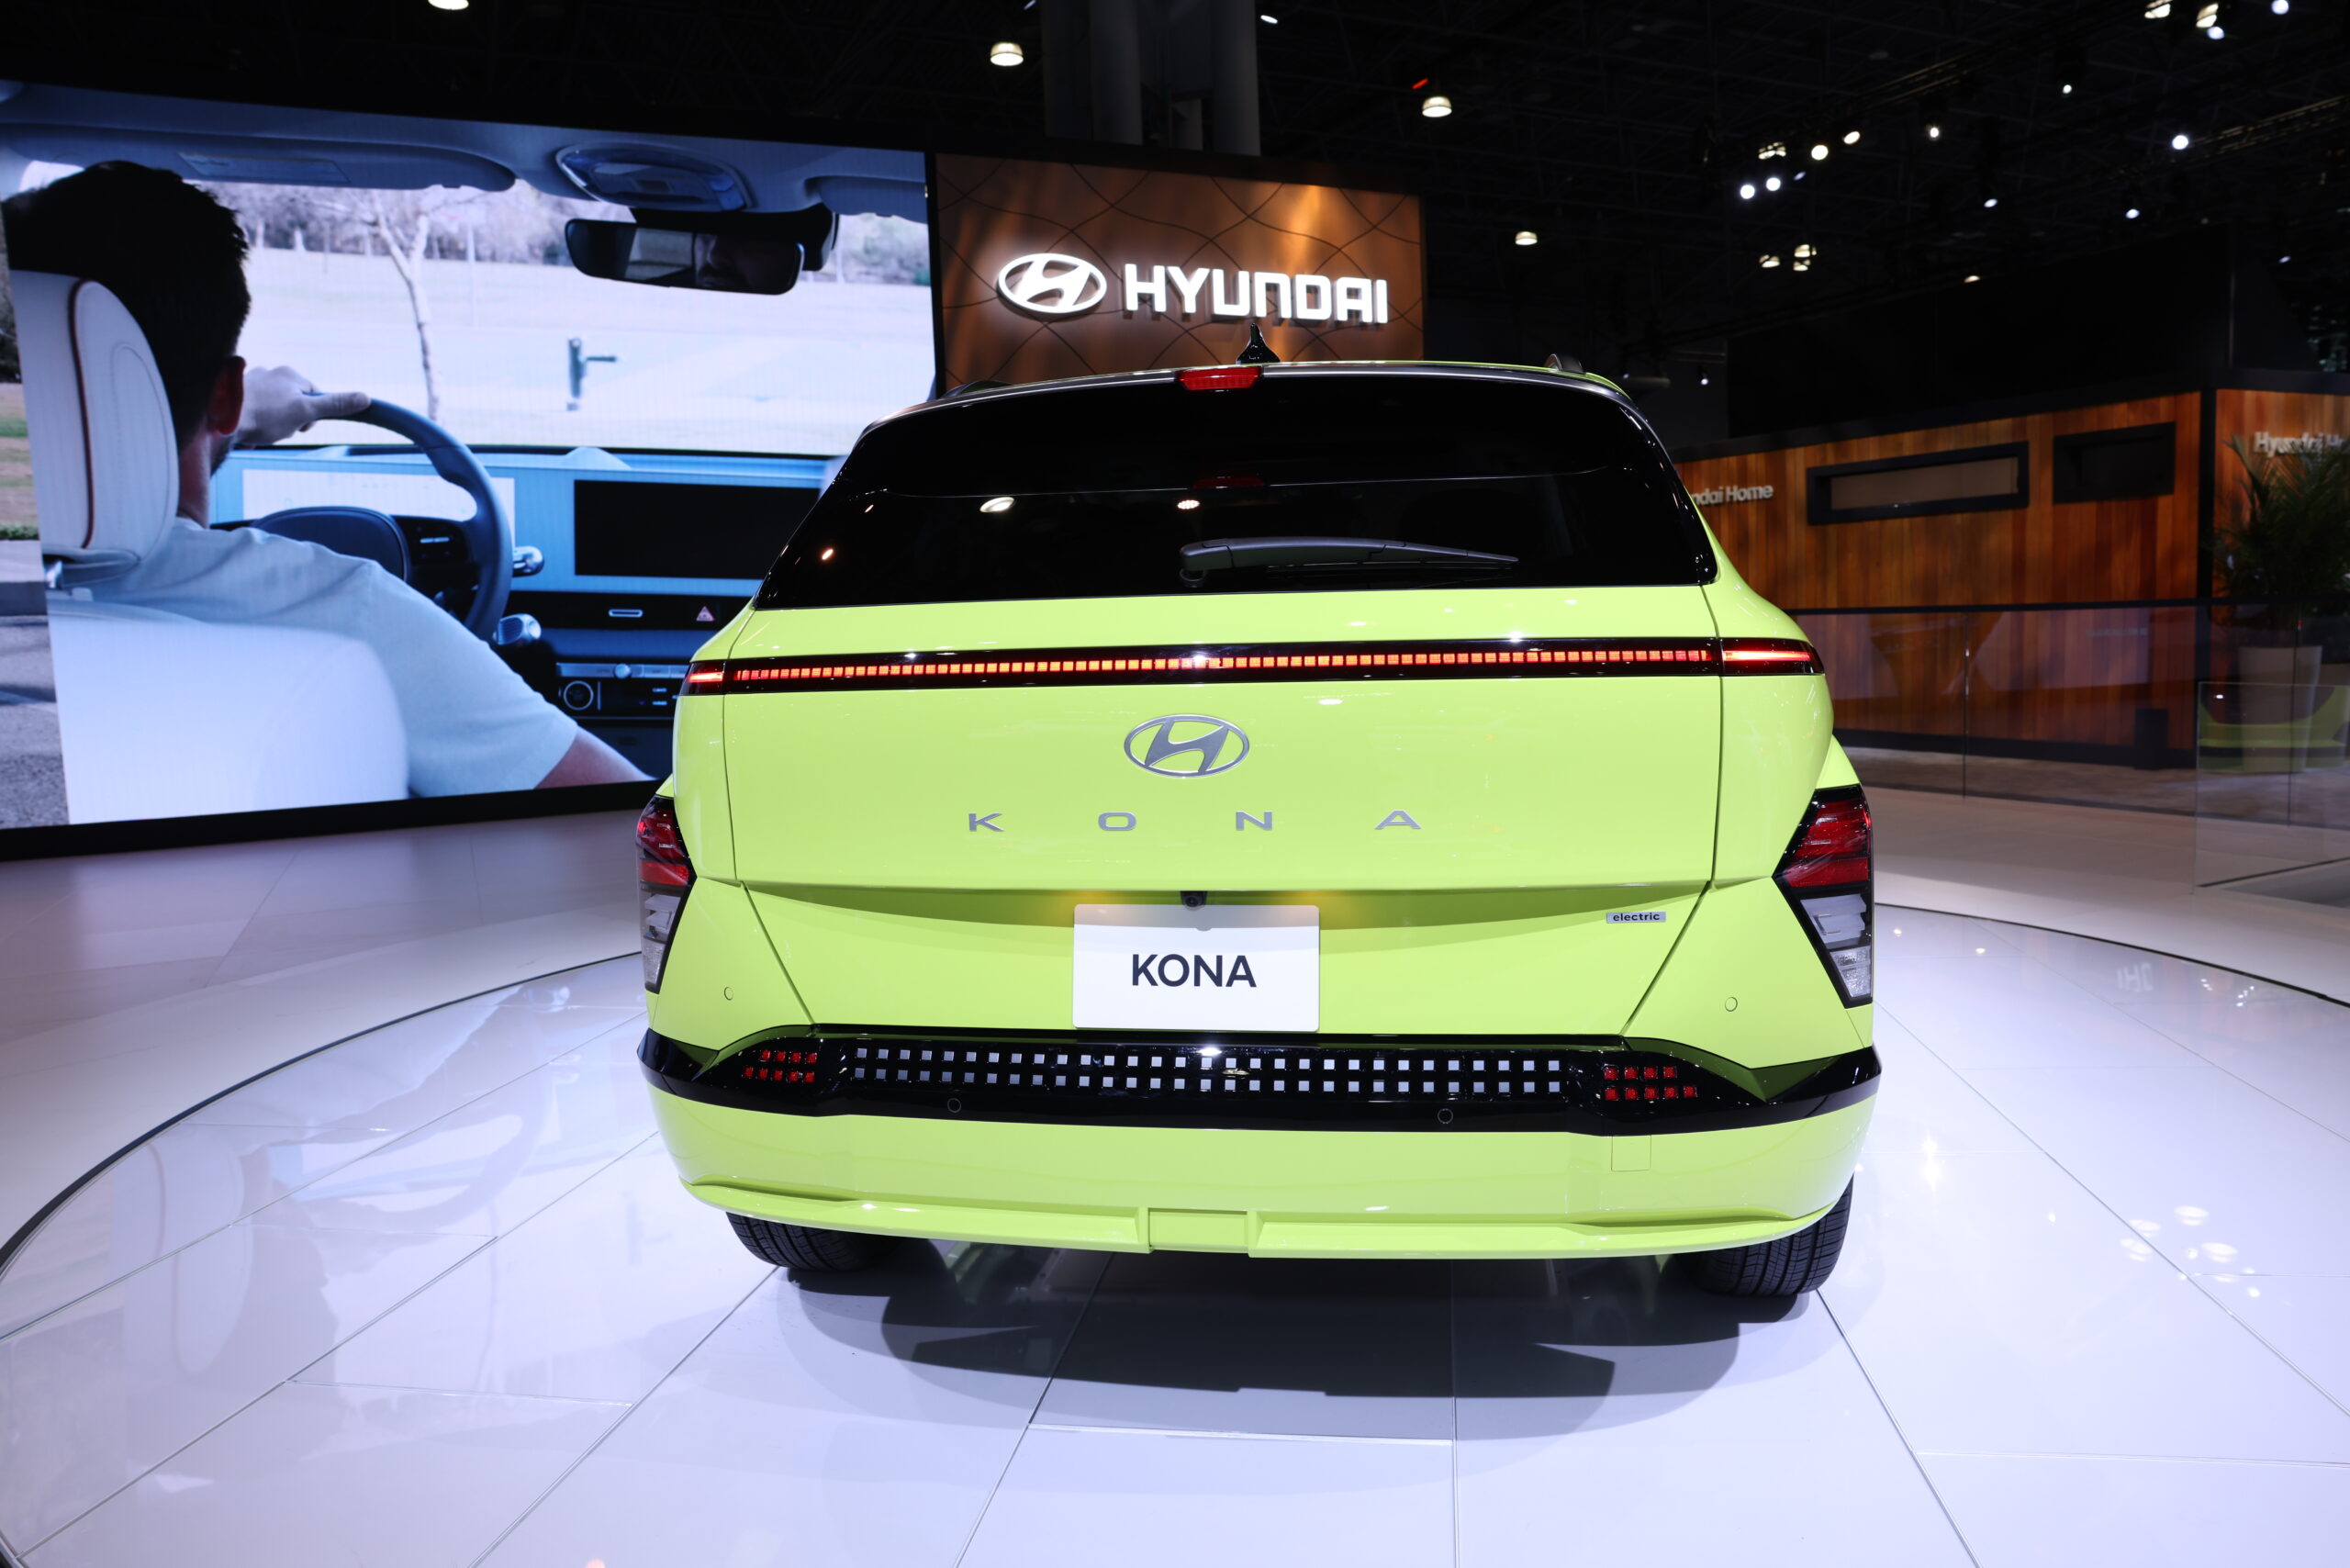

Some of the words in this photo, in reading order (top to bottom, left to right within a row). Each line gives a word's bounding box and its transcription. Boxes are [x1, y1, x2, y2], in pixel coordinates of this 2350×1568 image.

[1125, 263, 1389, 324] HYUNDAI
[1691, 486, 1724, 506] ndai
[1726, 485, 1774, 502] Home
[968, 810, 1421, 832] KONA
[1613, 912, 1661, 922] electric
[1132, 954, 1257, 988] KONA
